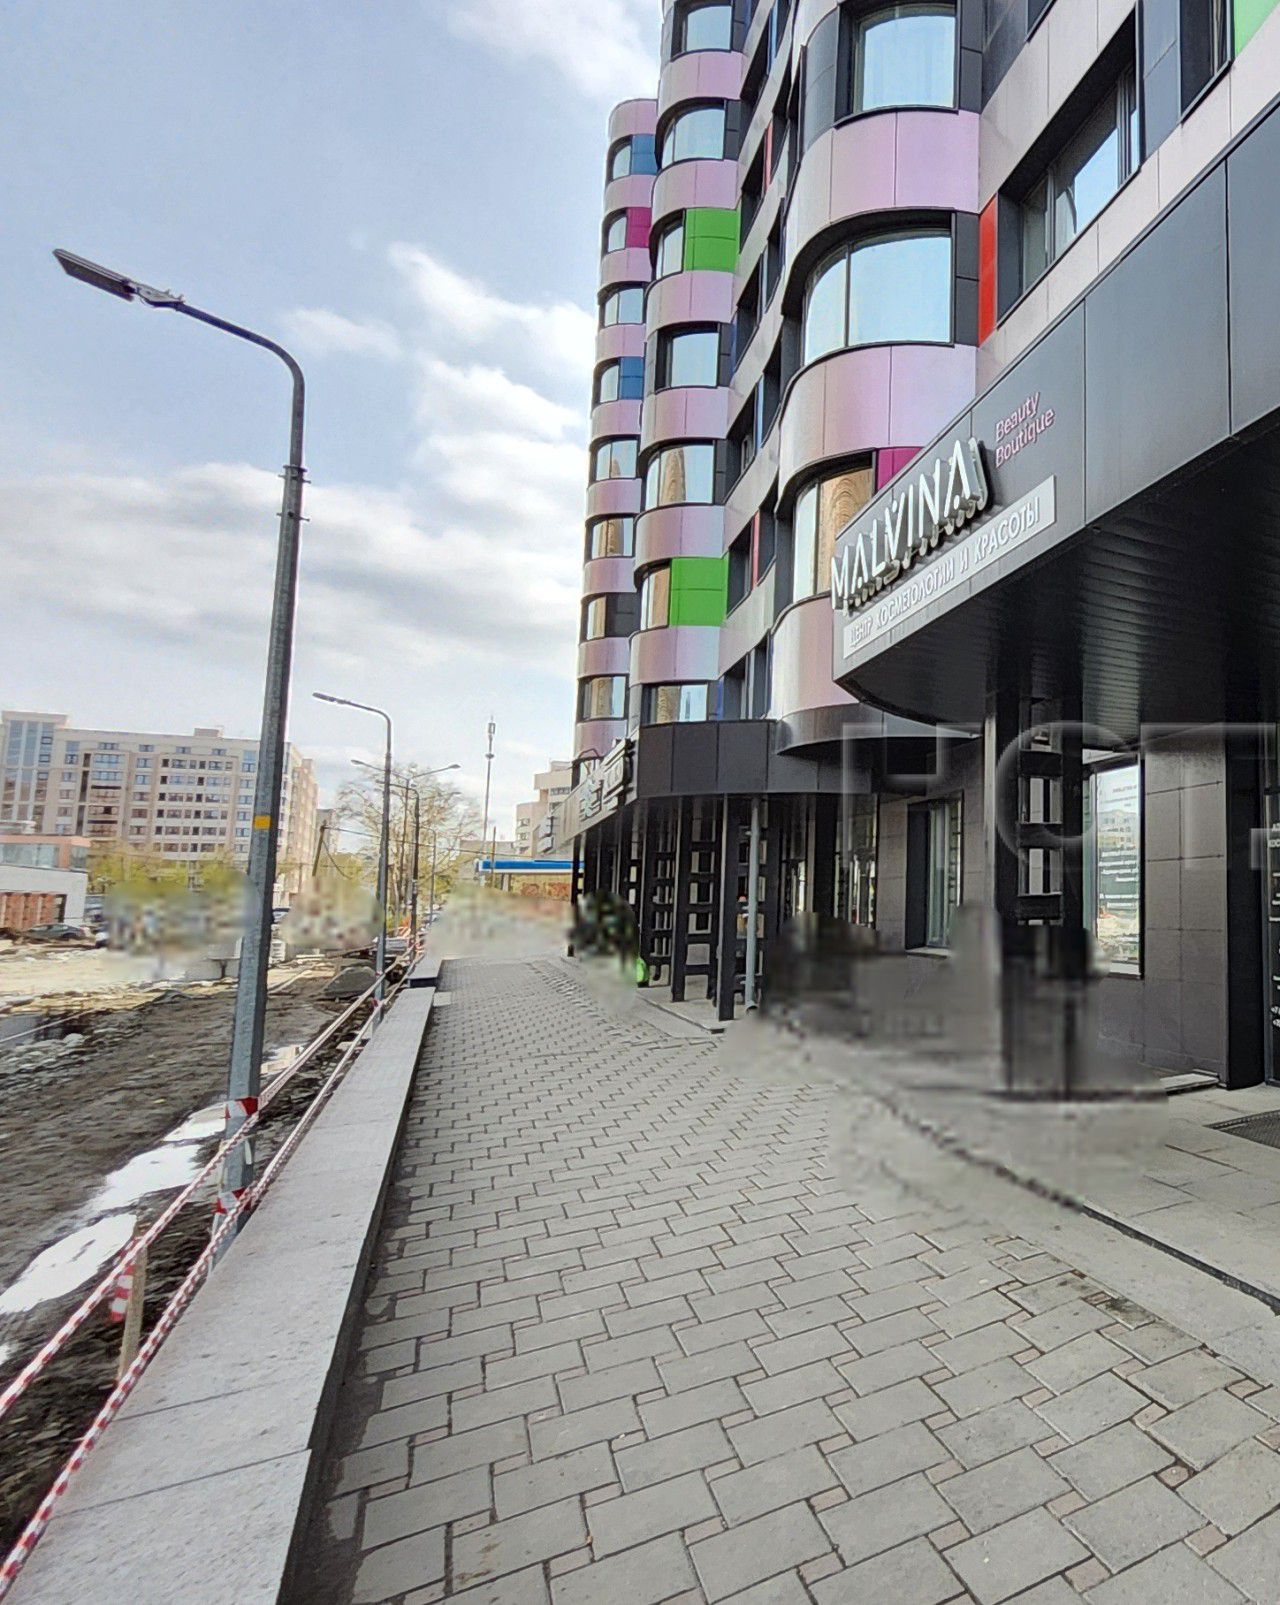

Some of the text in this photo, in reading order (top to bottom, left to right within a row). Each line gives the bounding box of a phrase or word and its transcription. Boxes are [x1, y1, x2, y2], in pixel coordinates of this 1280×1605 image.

[996, 392, 1040, 443] Beauty
[996, 408, 1054, 468] Boutique
[974, 496, 1040, 565] КРАСОТЫ
